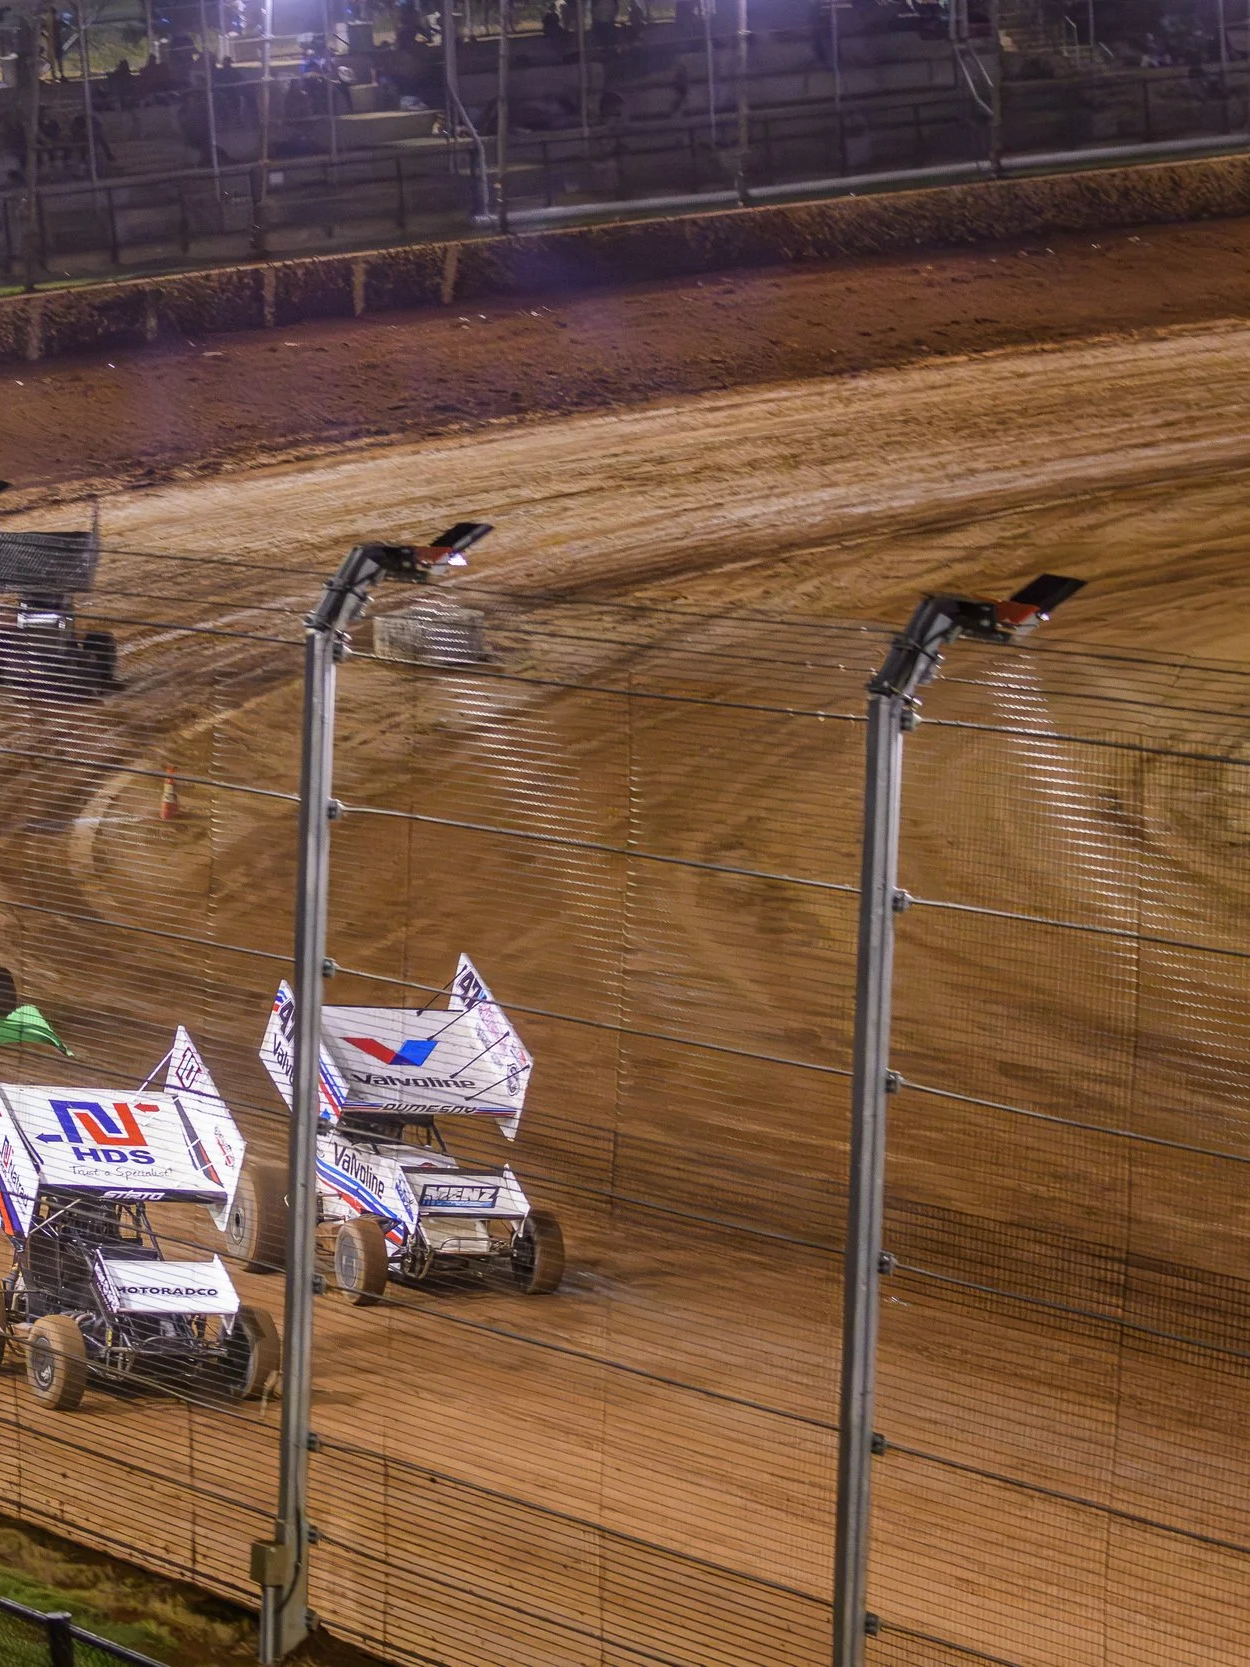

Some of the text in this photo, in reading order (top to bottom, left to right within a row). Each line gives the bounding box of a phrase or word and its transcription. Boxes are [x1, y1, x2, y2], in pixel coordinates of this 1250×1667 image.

[176, 1047, 201, 1089] 10
[351, 1073, 477, 1089] Valvoline
[382, 1102, 477, 1114] DUMESNY
[71, 1146, 155, 1165] HDS
[69, 1165, 100, 1176] Trust
[334, 1142, 385, 1199] Valvoline
[118, 1286, 218, 1297] MOTORADCO
